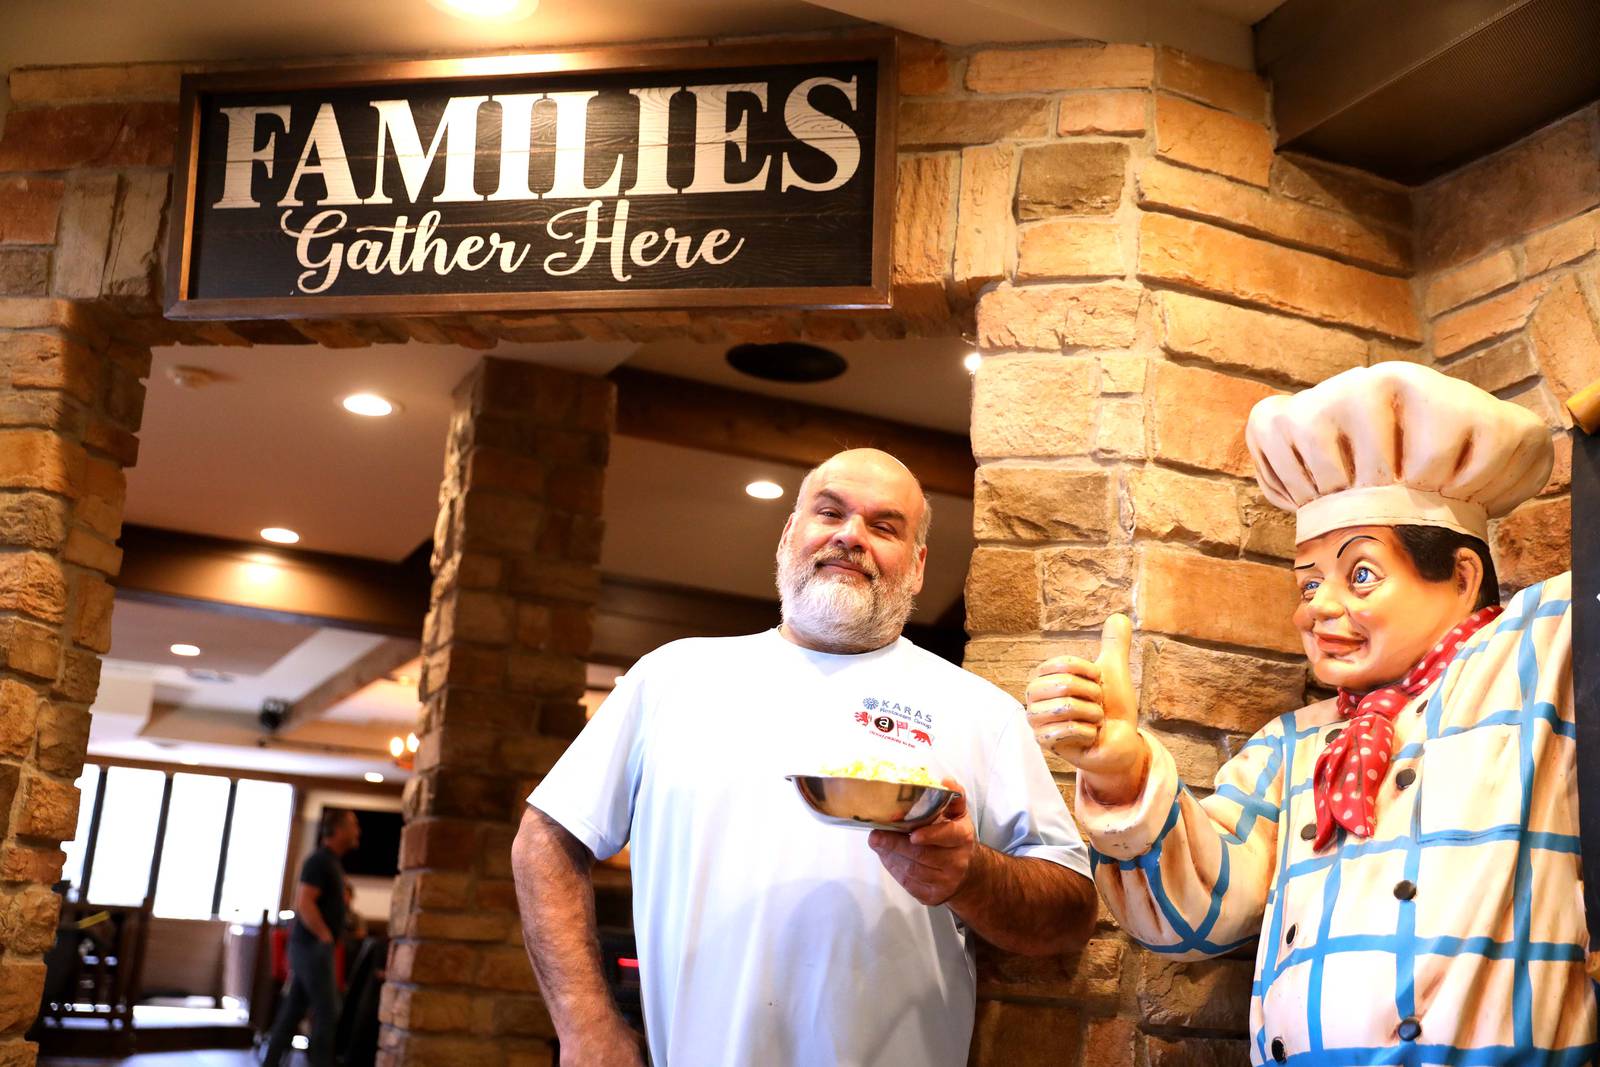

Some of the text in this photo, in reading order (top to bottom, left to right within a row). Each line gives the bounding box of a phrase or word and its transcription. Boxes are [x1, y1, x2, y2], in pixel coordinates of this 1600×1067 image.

[213, 75, 862, 210] FAMILIES
[280, 199, 745, 294] Gather Here
[881, 699, 932, 723] KARAS
